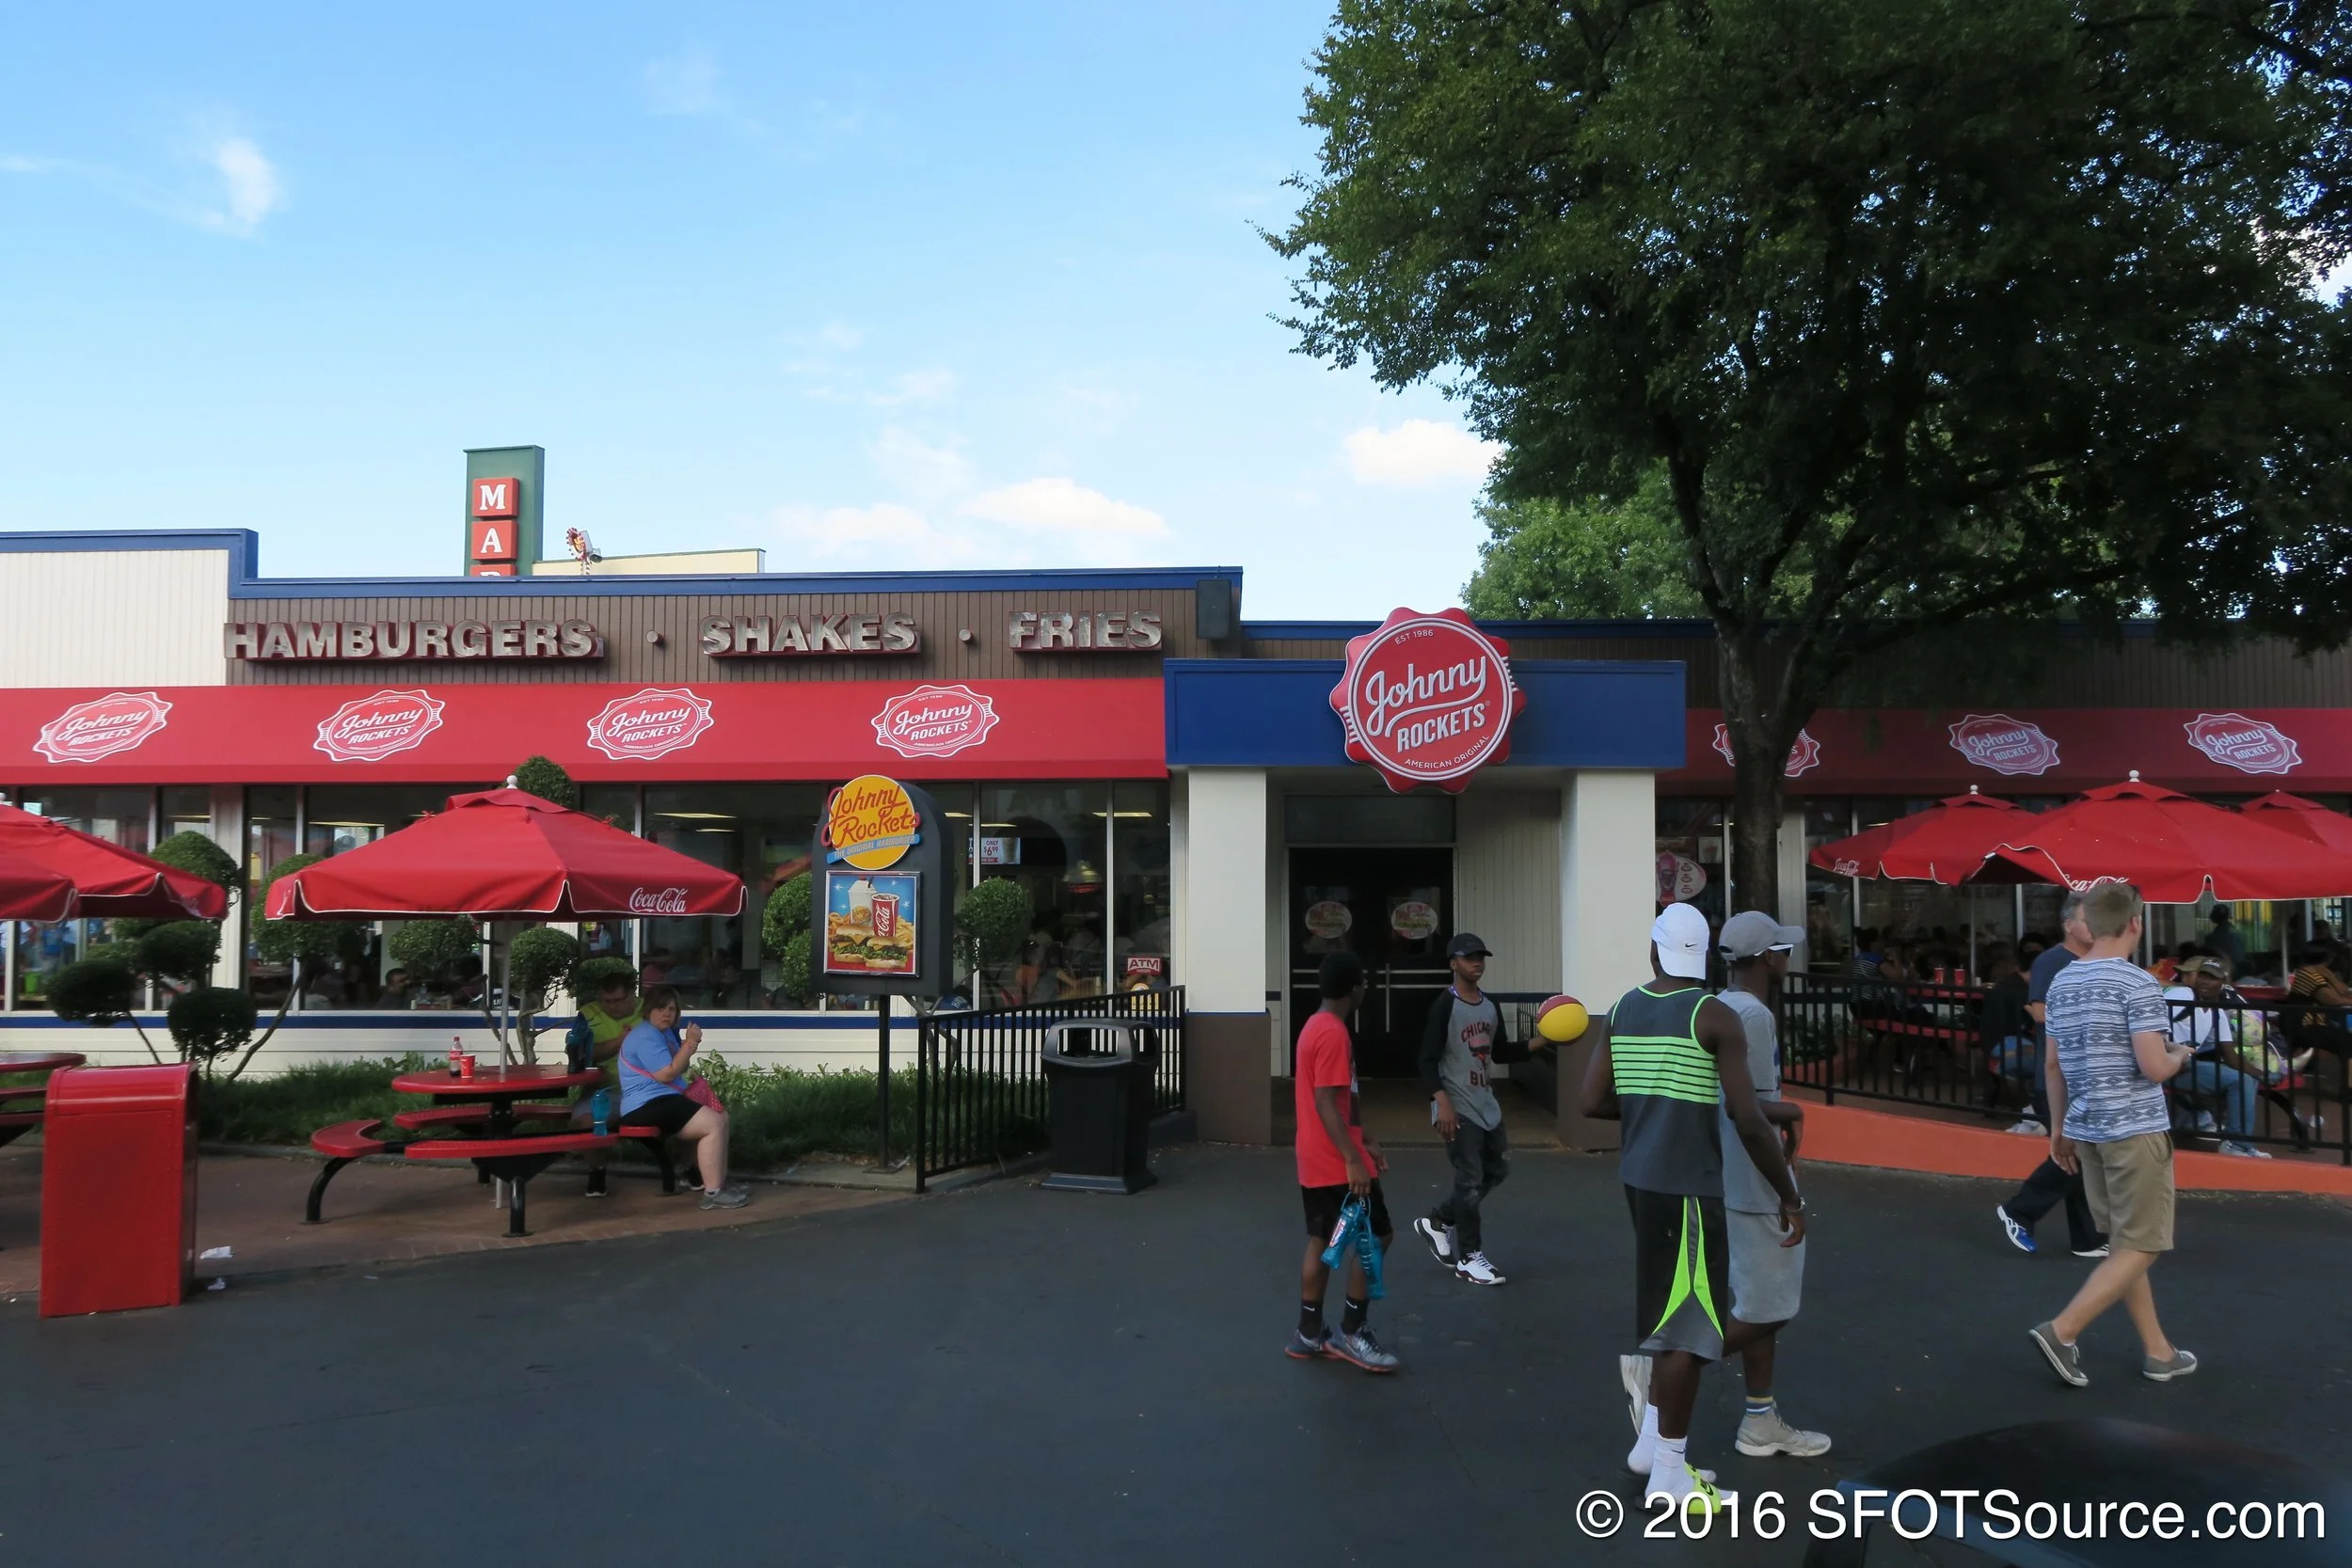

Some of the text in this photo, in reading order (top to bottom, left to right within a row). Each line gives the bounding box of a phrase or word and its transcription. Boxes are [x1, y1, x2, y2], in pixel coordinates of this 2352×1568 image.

[478, 483, 507, 576] MA
[223, 610, 1162, 659] HAMBURGERS SHAKES FRIES
[1394, 629, 1434, 644] EST 1986
[1365, 656, 1486, 737] Johnny
[56, 709, 151, 741] Johnny
[334, 708, 423, 739] Johnny
[606, 706, 691, 737] Johnny
[621, 723, 684, 743] ROCKETS
[892, 704, 973, 736] Johnny
[910, 721, 969, 741] ROCKETS
[1397, 703, 1486, 753] ROCKETS
[347, 724, 412, 745] ROCKETS
[1968, 730, 2029, 756] Johnny
[2205, 729, 2267, 755] Johnny
[1405, 735, 1489, 769] AMERICAN ORIGINAL
[1994, 744, 2037, 761] ROCKETS
[2233, 743, 2277, 760] ROCKETS
[820, 784, 907, 847] Johnny
[832, 807, 921, 848] Rockets
[834, 849, 846, 859] THE
[628, 887, 689, 913] Coca-Cola
[1129, 958, 1159, 970] ATM
